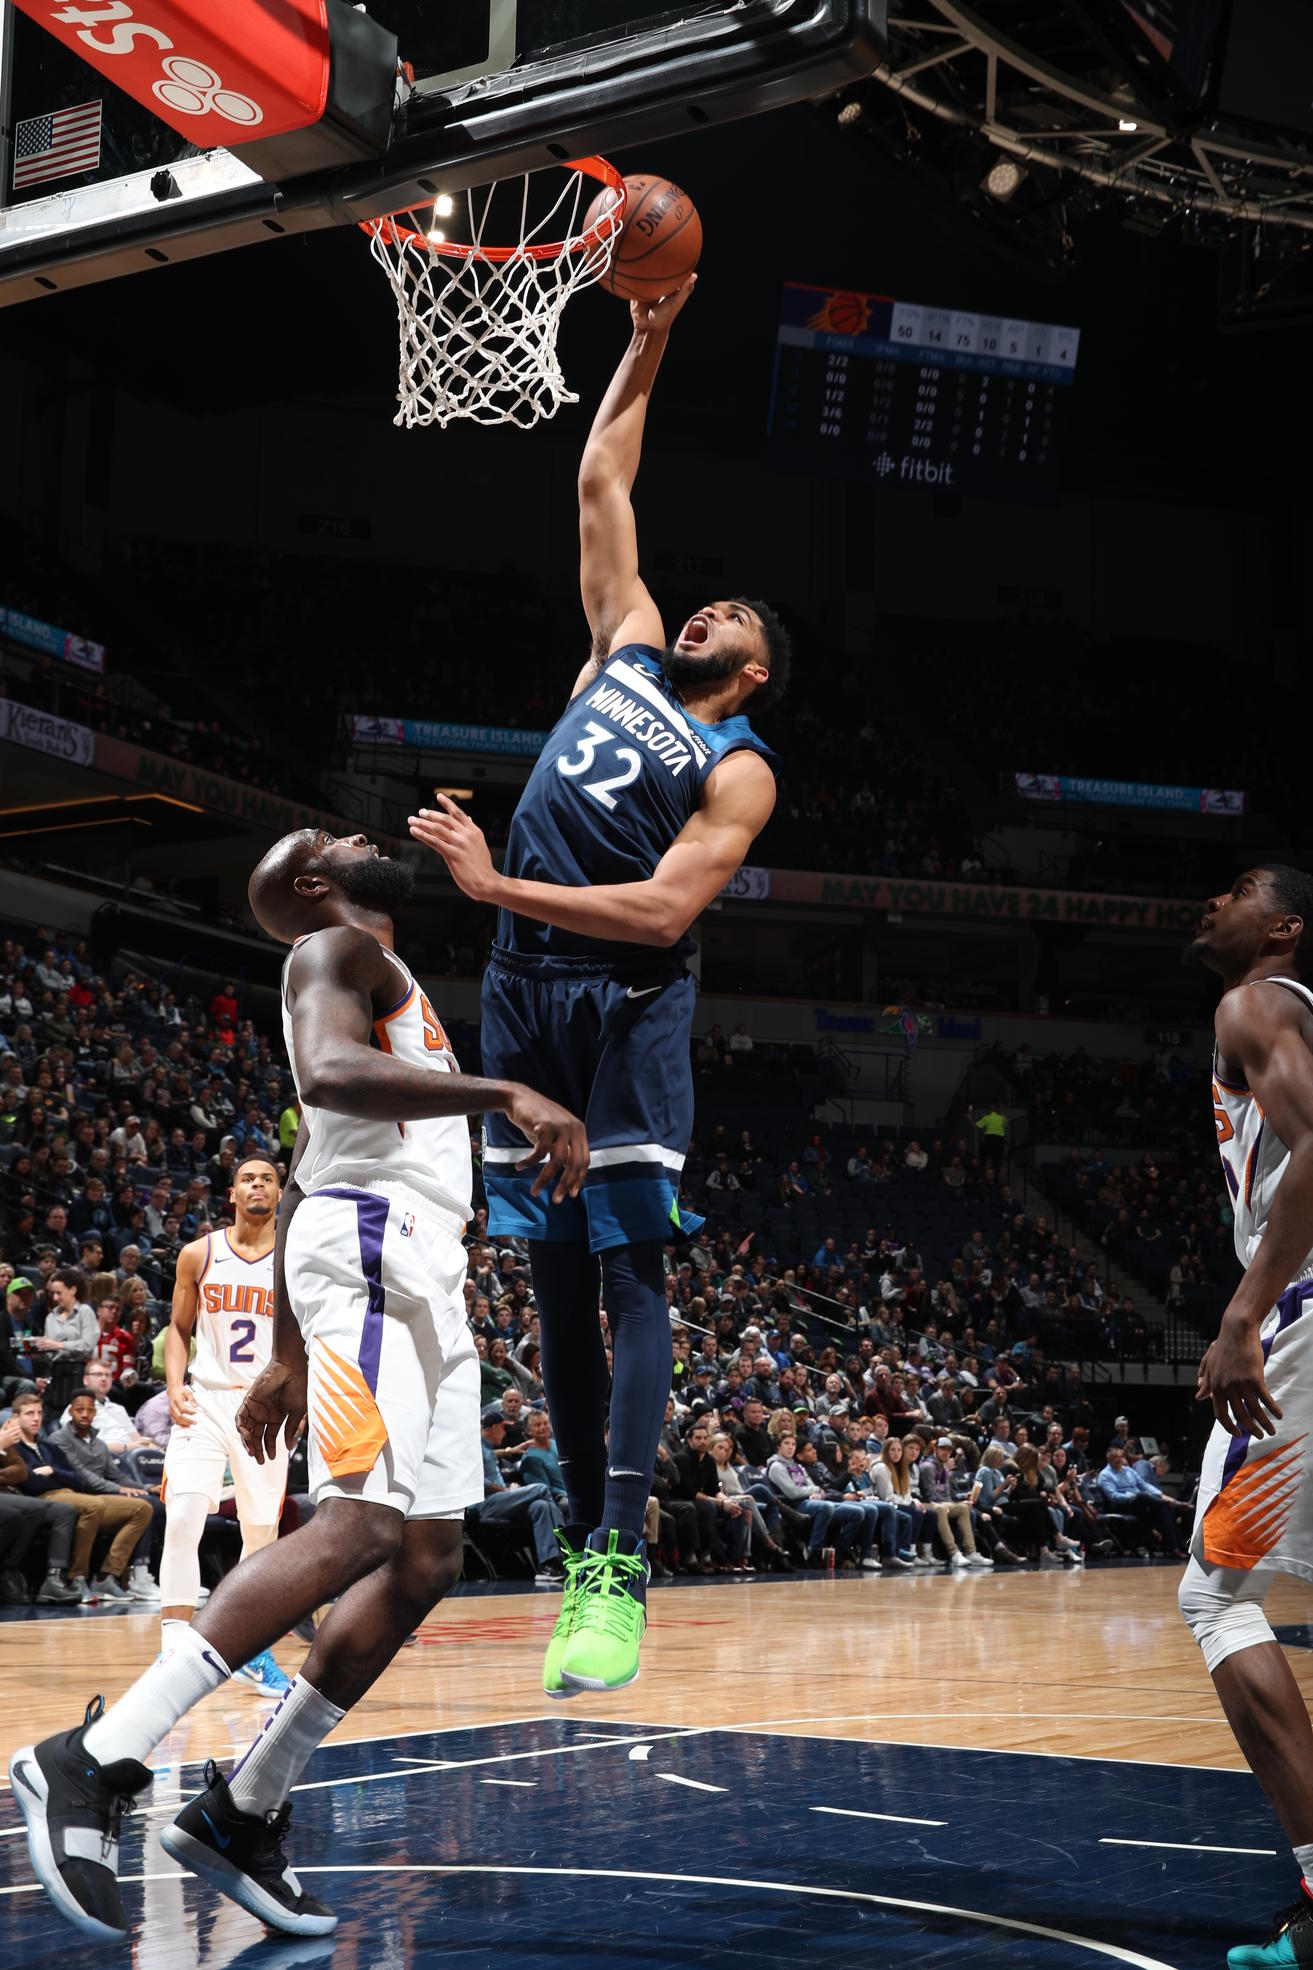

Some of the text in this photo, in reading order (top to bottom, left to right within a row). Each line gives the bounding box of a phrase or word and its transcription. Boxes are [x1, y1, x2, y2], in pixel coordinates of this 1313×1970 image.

[50, 0, 174, 55] St
[898, 326, 912, 338] 50
[928, 330, 942, 342] 14
[956, 334, 970, 347] 75
[983, 338, 997, 351] 10
[1010, 341, 1017, 353] 5
[1060, 350, 1067, 360] 4
[825, 370, 846, 385] 0/0
[918, 384, 938, 398] 0/0
[979, 392, 987, 405] 0
[1025, 399, 1034, 411] 0
[827, 353, 848, 368] 2/2
[920, 367, 940, 381] 0/0
[982, 375, 990, 388] 2
[1027, 382, 1036, 394] 0
[825, 388, 845, 402] 1/2
[915, 401, 935, 415] 0/0
[820, 422, 840, 437] 0/0
[911, 435, 931, 449] 0/0
[973, 442, 981, 455] 0
[1019, 449, 1027, 462] 0
[822, 405, 842, 419] 3/6
[913, 418, 933, 432] 2/2
[975, 426, 983, 439] 0
[900, 455, 954, 484] fitbit
[414, 723, 487, 741] TREASURE
[490, 729, 542, 745] ISLAND
[585, 682, 692, 777] MINNESOTA
[557, 720, 642, 810] 32
[138, 755, 187, 793] MAY
[191, 771, 237, 811] YOU
[242, 791, 293, 830] HAVE
[1070, 779, 1134, 796] TREASURE
[1137, 784, 1184, 800] ISLAND
[821, 878, 881, 903] MAY
[888, 884, 944, 910] YOU
[953, 889, 1020, 915] HAVE
[1028, 894, 1058, 918] 24
[1065, 896, 1149, 925] HAPPY
[1157, 1031, 1181, 1045] 118
[229, 1319, 257, 1363] 2
